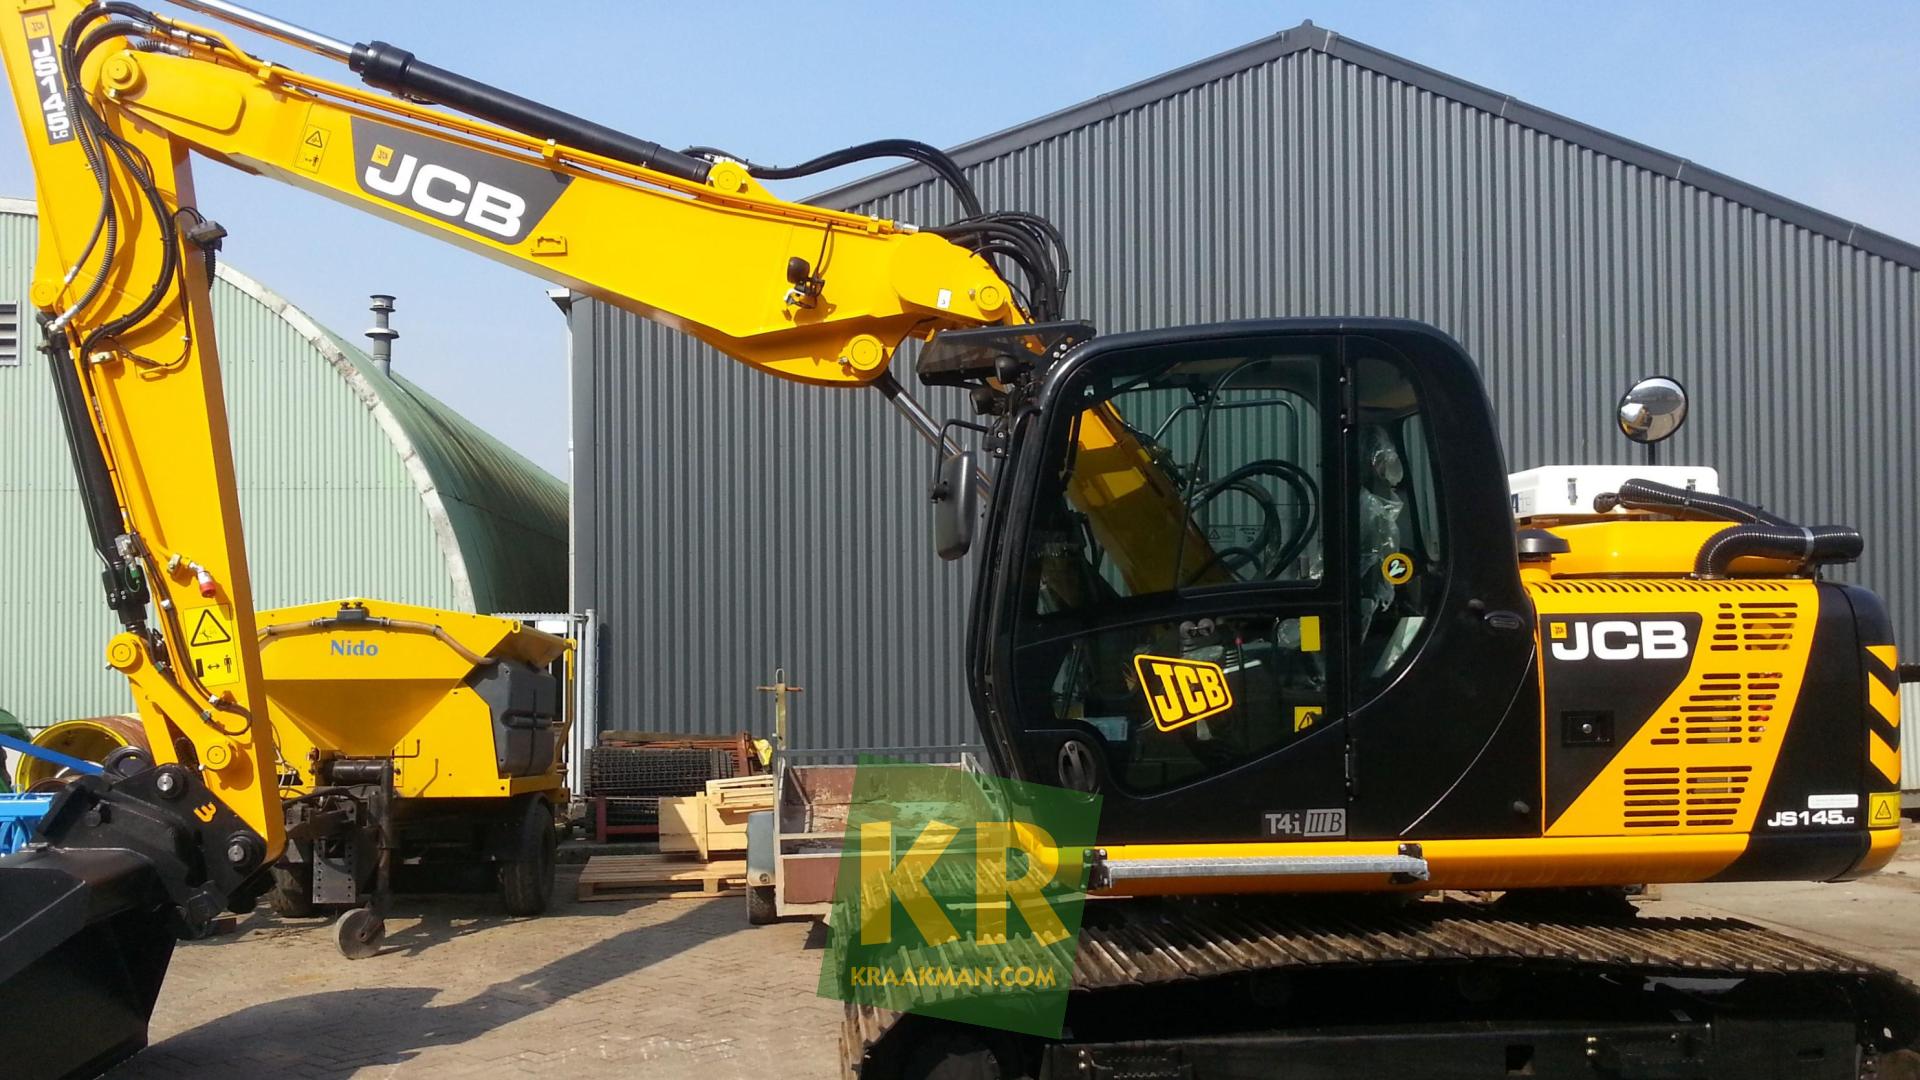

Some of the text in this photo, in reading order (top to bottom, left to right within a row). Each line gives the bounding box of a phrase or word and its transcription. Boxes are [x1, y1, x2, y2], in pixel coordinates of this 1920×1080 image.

[365, 154, 526, 237] JCB
[331, 639, 379, 656] Nido
[1551, 621, 1689, 661] JCB
[1151, 663, 1226, 722] JCB
[1265, 813, 1302, 834] T4i
